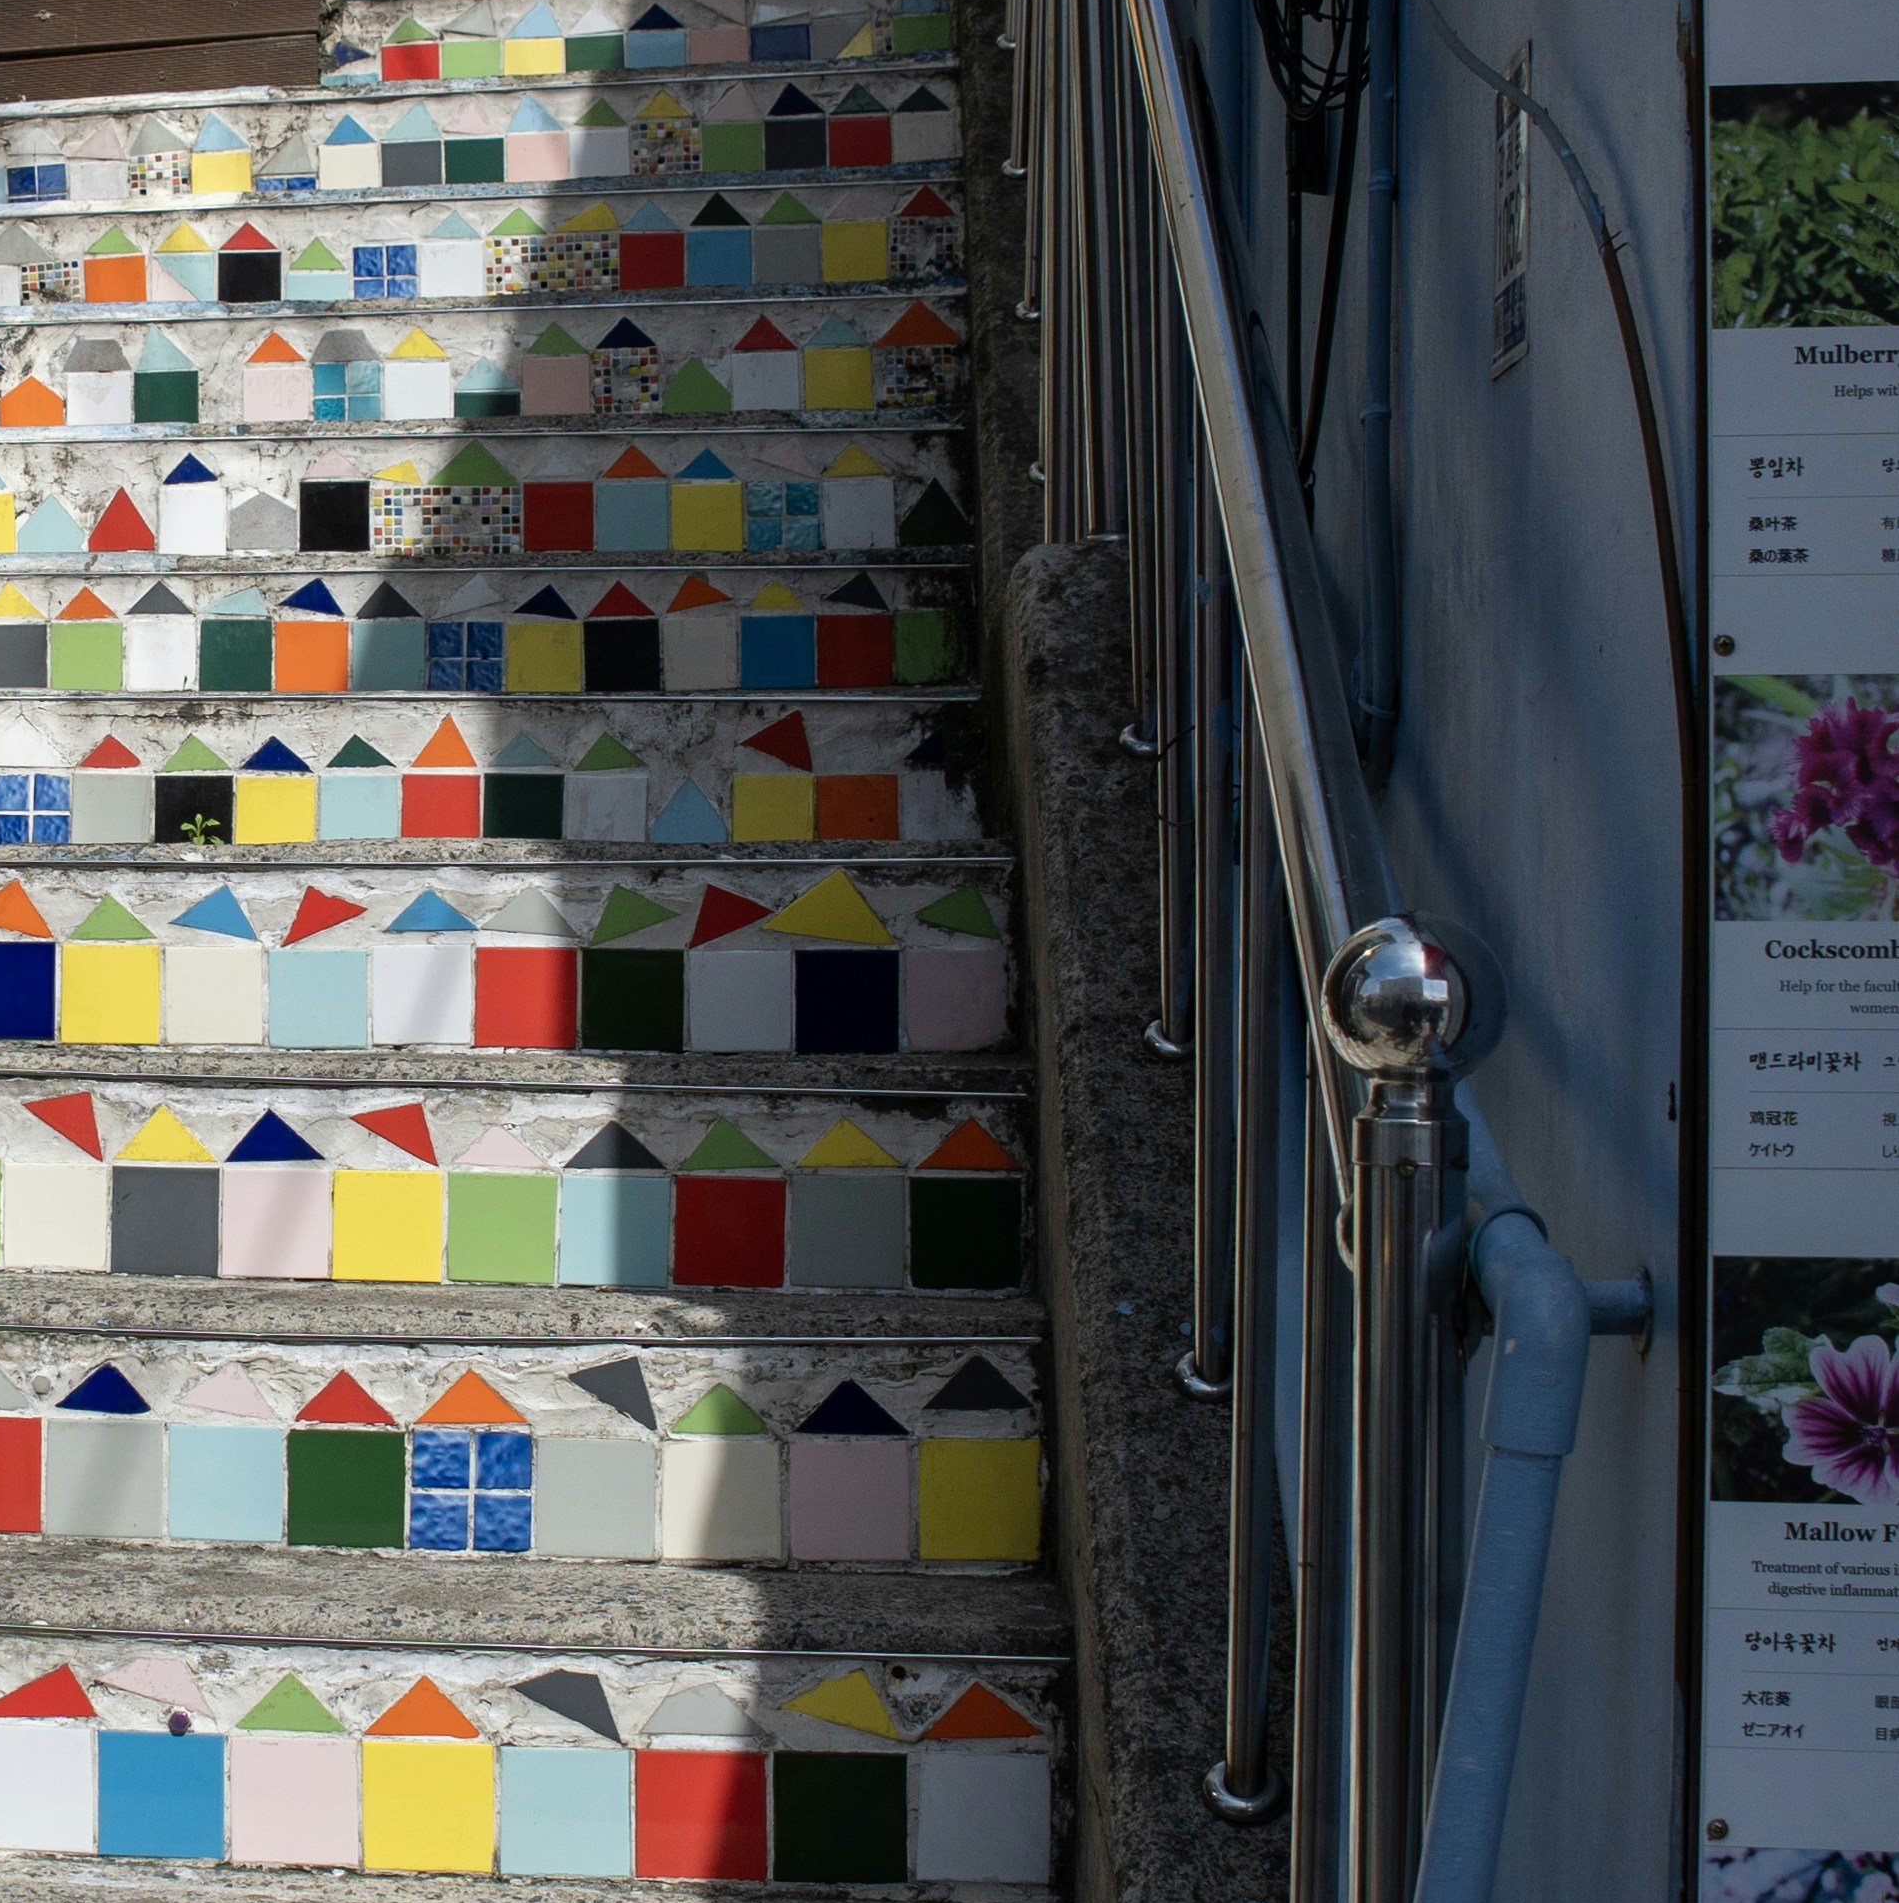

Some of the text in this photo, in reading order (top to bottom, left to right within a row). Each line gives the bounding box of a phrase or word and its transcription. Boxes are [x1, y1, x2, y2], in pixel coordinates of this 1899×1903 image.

[1794, 344, 1899, 365] Mulberr
[1834, 385, 1874, 399] Helps
[1750, 457, 1805, 478] 뽕잎차
[1748, 516, 1797, 532] 桑叶茶
[1881, 516, 1899, 530] 有
[1748, 548, 1809, 564] 桑の葉茶
[1881, 548, 1899, 563] 糖
[1779, 979, 1812, 994] Help
[1816, 980, 1835, 992] for
[1839, 980, 1860, 992] the
[1749, 1051, 1861, 1073] 맨드라미꽃차
[1749, 1111, 1798, 1126] 鸡冠花
[1749, 1143, 1794, 1158] ケイトウ
[1784, 1521, 1899, 1542] Mallow F
[1752, 1560, 1890, 1575] Treatment of various
[1768, 1582, 1827, 1597] digestive
[1745, 1632, 1836, 1653] 당아욱꽃차
[1741, 1690, 1791, 1707] 大花葵
[1741, 1722, 1805, 1738] ゼニアオイ
